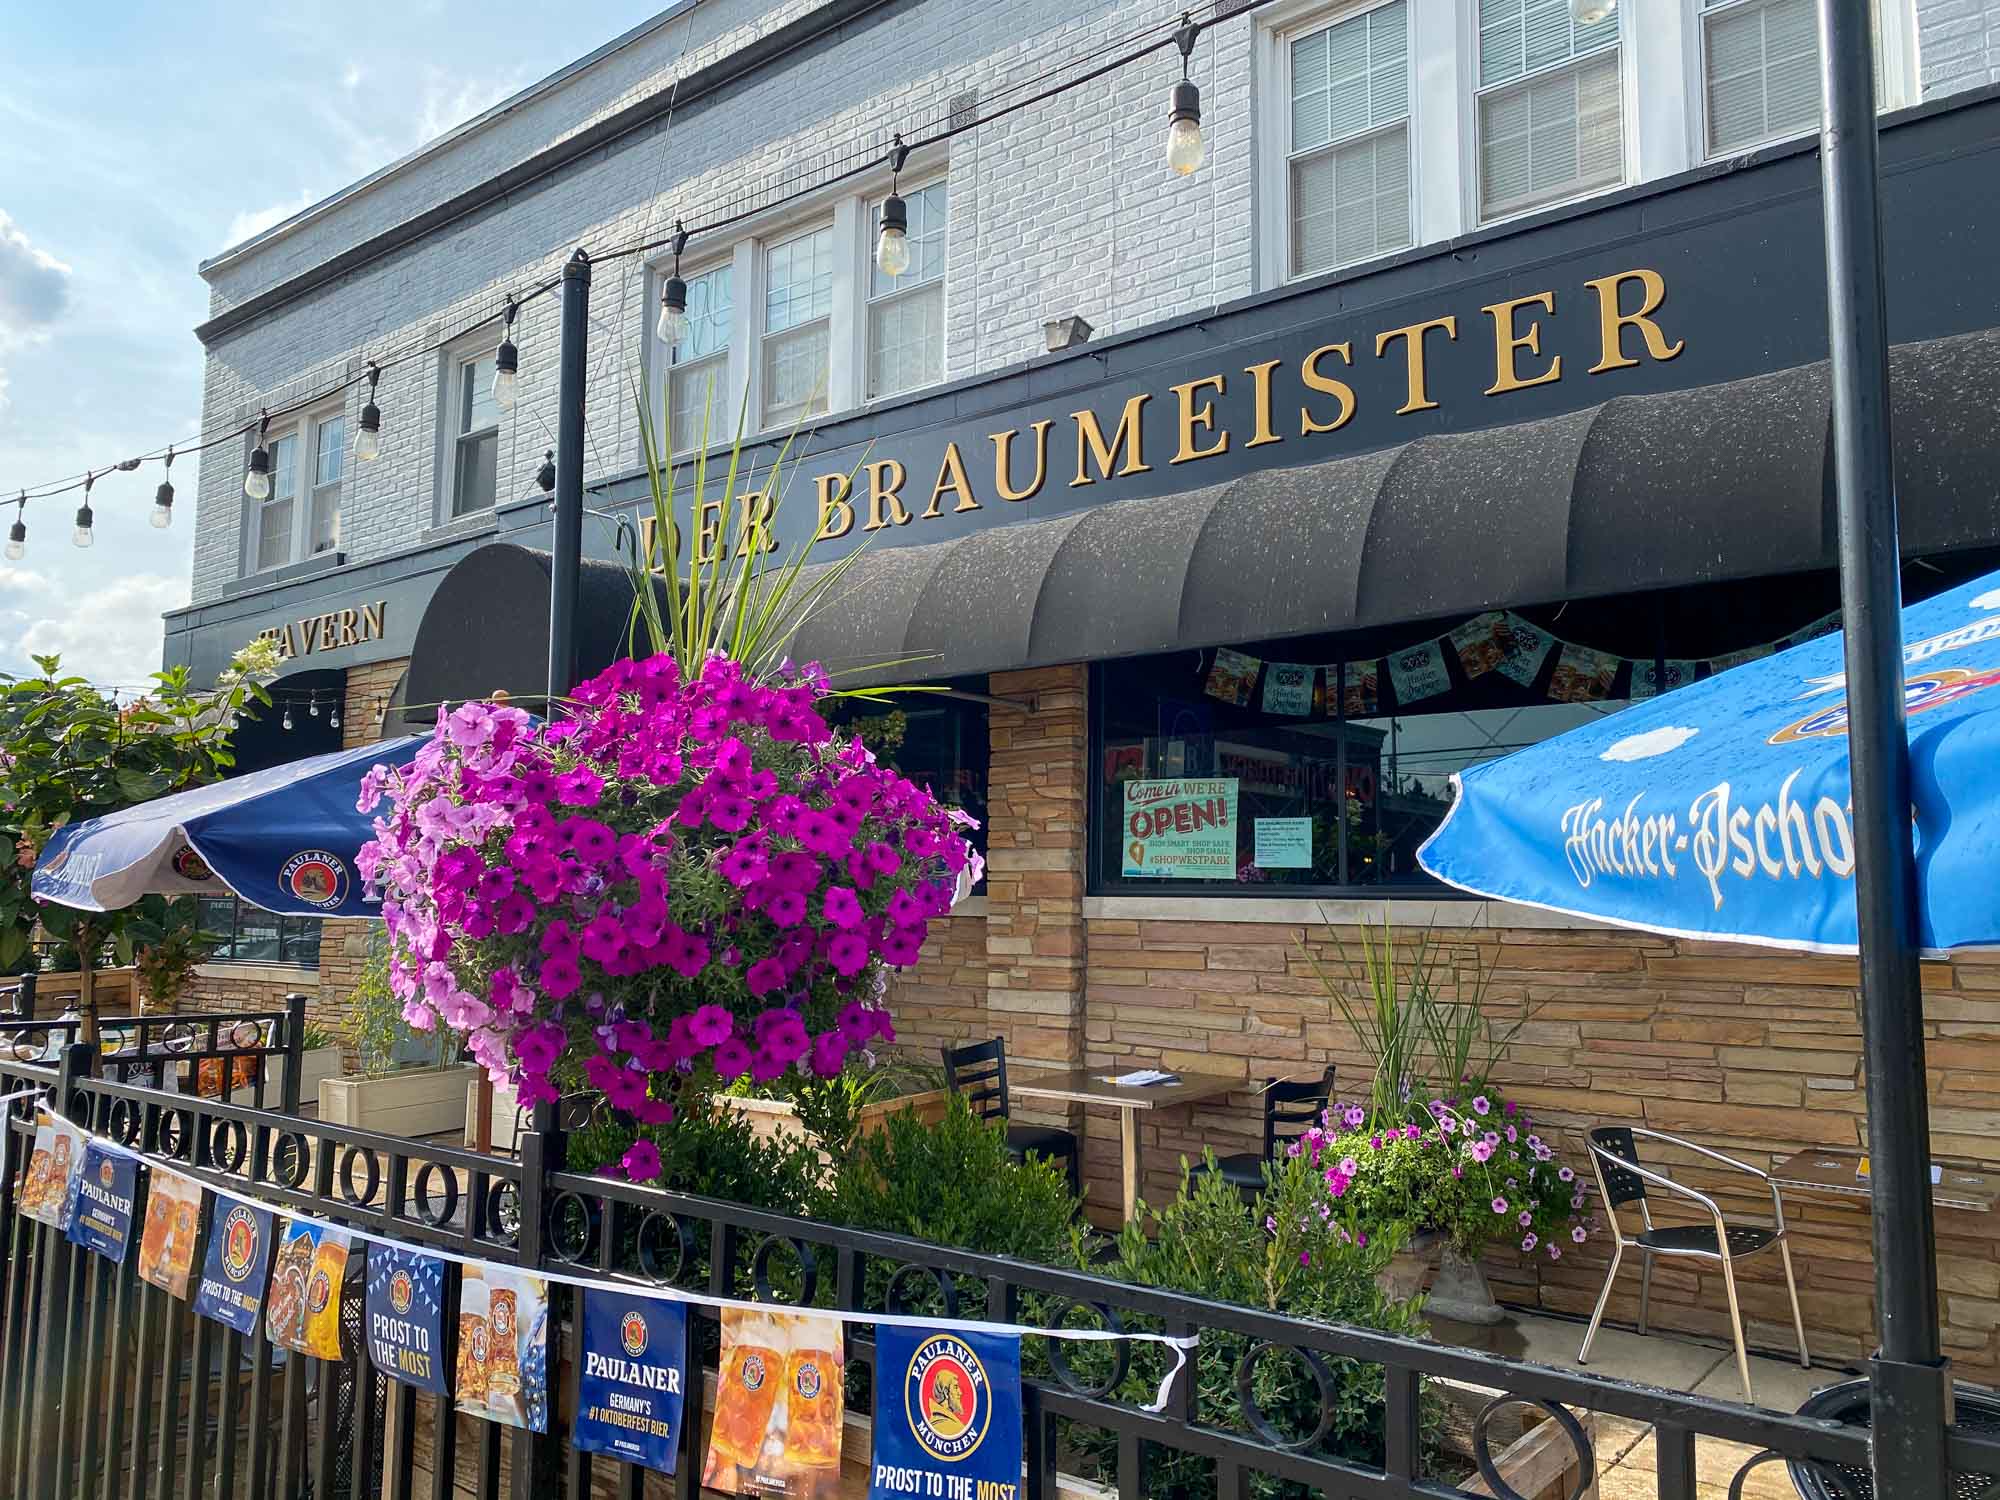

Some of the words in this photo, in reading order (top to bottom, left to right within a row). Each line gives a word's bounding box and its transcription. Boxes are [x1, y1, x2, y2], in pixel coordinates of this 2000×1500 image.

[813, 269, 1685, 540] BRAUMEISTER
[1127, 781, 1163, 802] Come
[1165, 782, 1180, 796] in
[1184, 782, 1225, 795] WE'RE
[1130, 798, 1229, 839] OPEN!
[1561, 767, 1855, 911] Hacker-Pscho
[283, 852, 343, 877] PAULANER
[80, 1179, 131, 1216] PAULANER
[201, 1279, 222, 1298] PROST
[223, 1286, 231, 1302] TO
[231, 1289, 242, 1307] THE
[242, 1295, 259, 1313] MOST
[373, 1312, 411, 1346] PROST
[413, 1326, 429, 1353] TO
[374, 1339, 397, 1368] THE
[398, 1348, 432, 1380] MOST
[585, 1351, 681, 1394] PAULANER
[911, 1340, 983, 1387] PAULANER
[588, 1406, 599, 1421] #1
[600, 1408, 650, 1433] OKTOBERFEST
[609, 1393, 652, 1415] GERMANY'S
[916, 1420, 978, 1454] MÜNCHEN
[875, 1464, 922, 1494] PROST
[925, 1472, 943, 1497] TO
[946, 1474, 973, 1500] THE
[977, 1479, 1017, 1500] MOST
